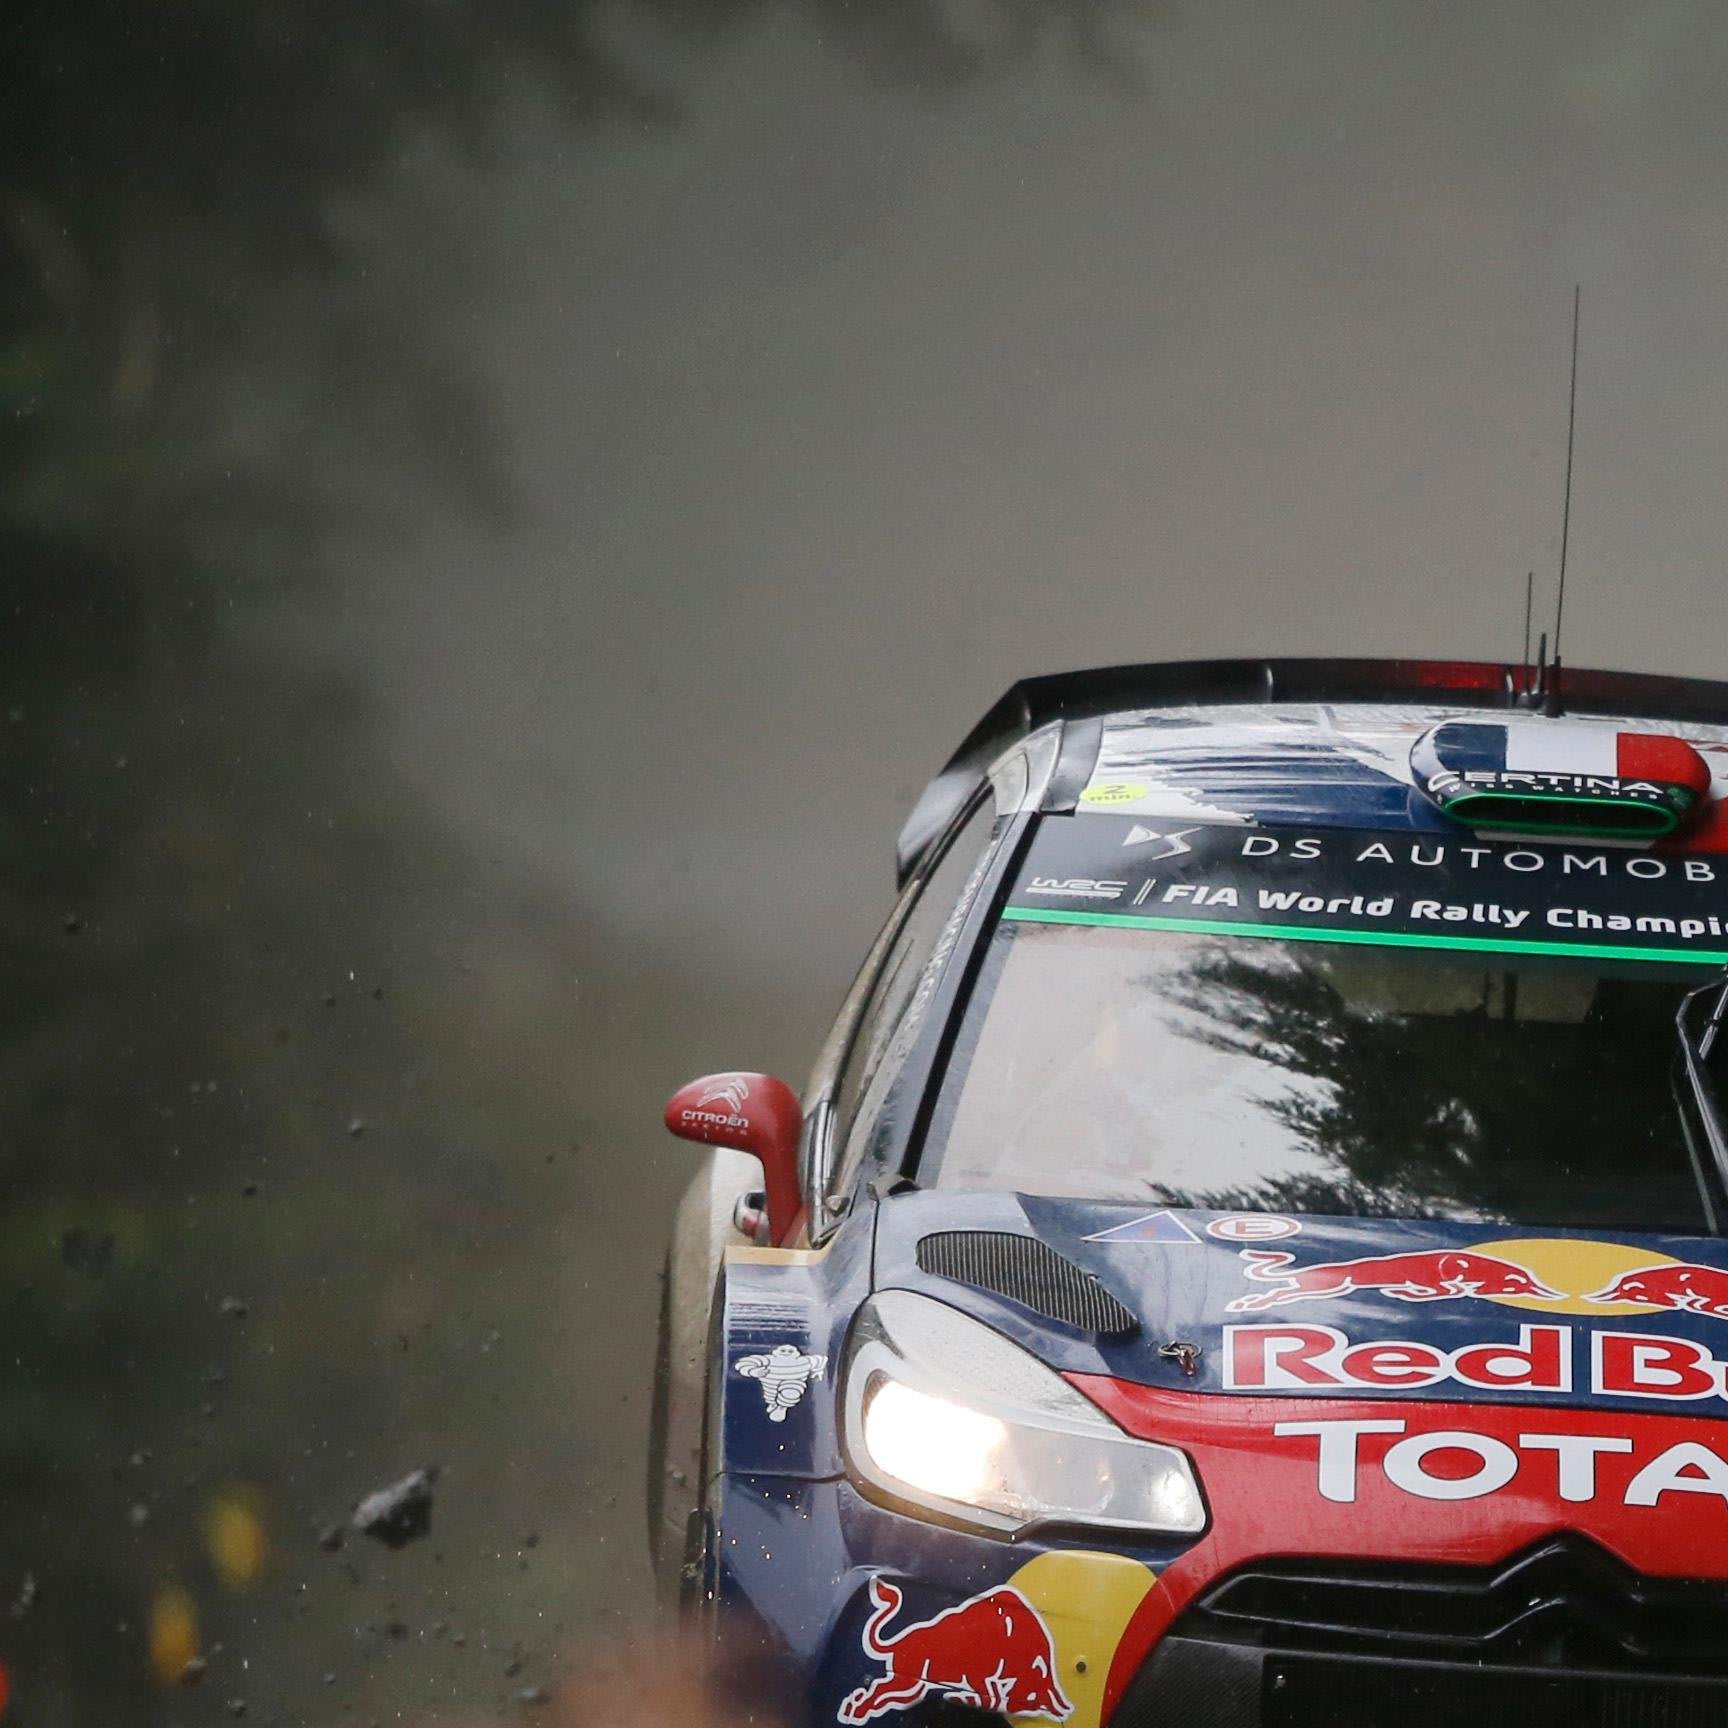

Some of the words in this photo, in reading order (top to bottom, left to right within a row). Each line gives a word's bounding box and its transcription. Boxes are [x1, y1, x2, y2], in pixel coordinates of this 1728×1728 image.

[1427, 771, 1664, 794] CERTINA
[1532, 785, 1658, 800] WATCHES
[1241, 837, 1322, 860] DS
[1162, 884, 1239, 907] FIA
[1258, 889, 1394, 916] World
[1410, 899, 1531, 928] Rally
[1223, 1324, 1573, 1394] Red
